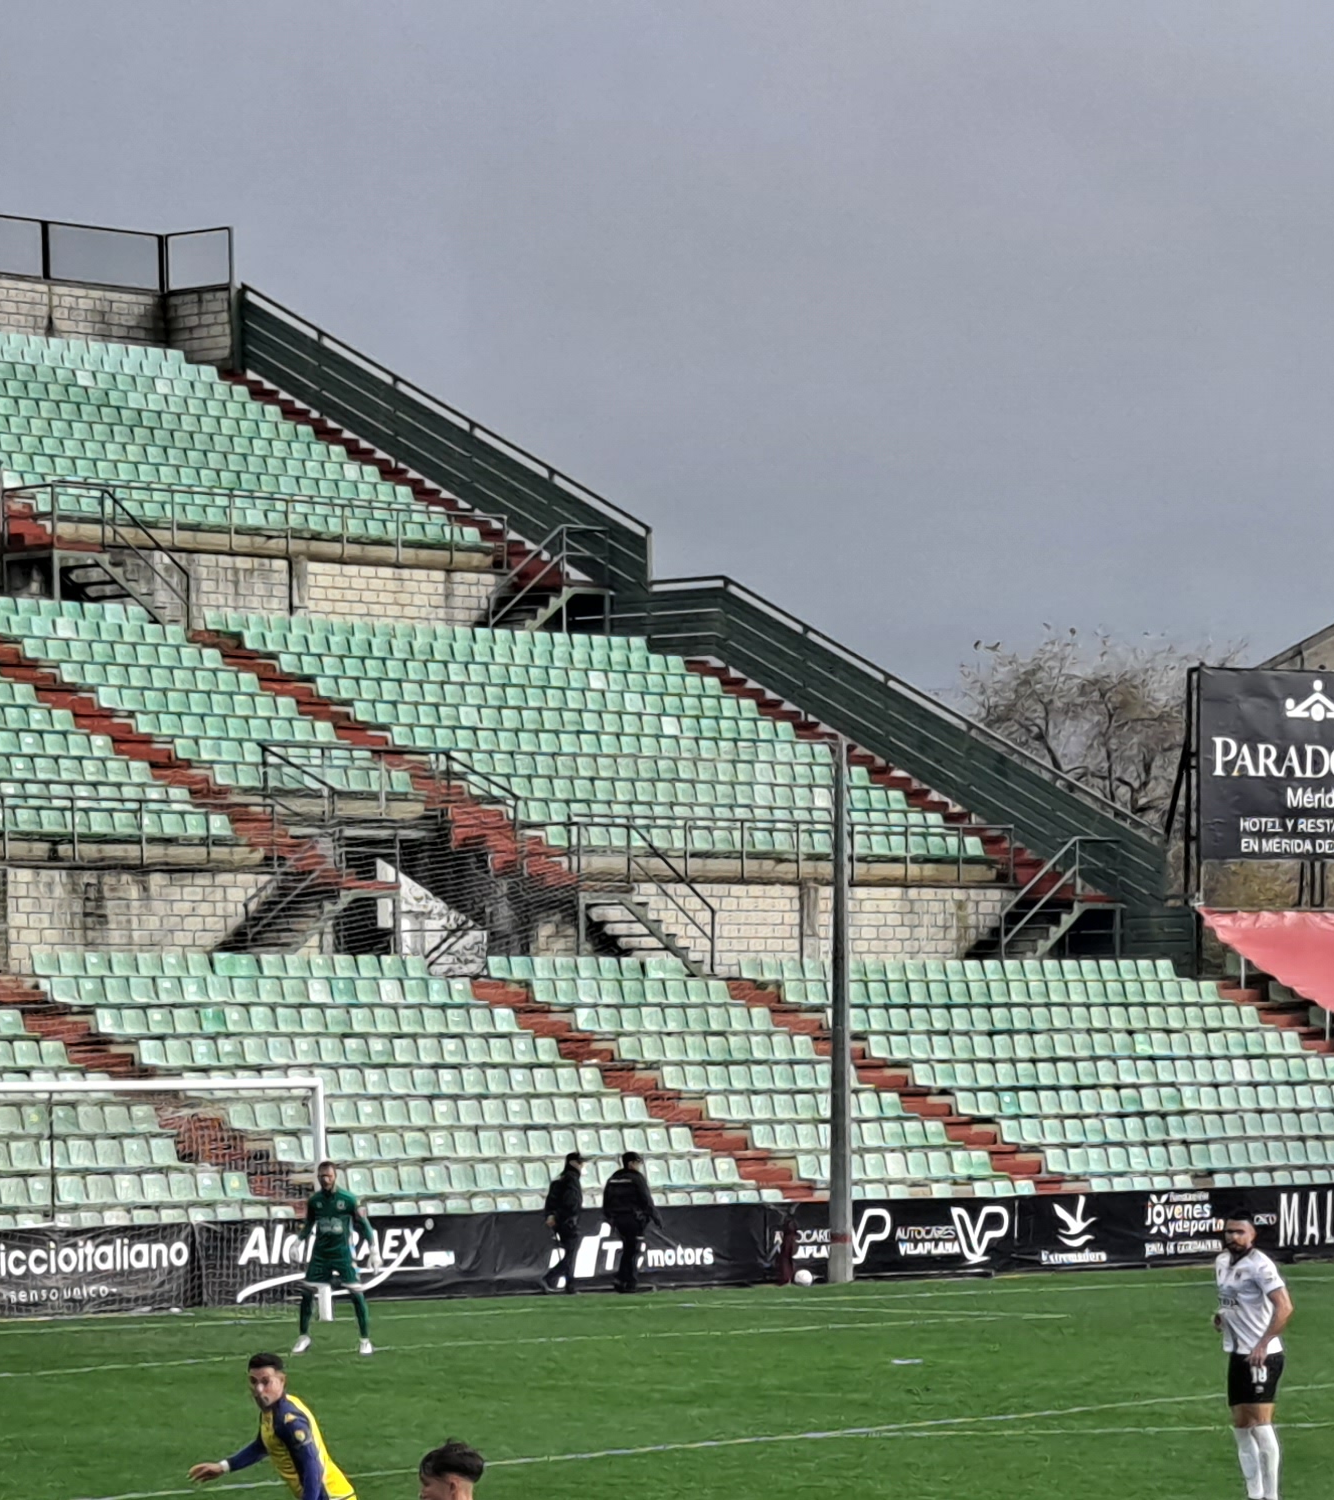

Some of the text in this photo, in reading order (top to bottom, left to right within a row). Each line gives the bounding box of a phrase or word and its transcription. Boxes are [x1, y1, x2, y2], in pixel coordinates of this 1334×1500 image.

[1240, 817, 1283, 832] HOTEL
[1286, 819, 1294, 832] Y
[1241, 838, 1259, 853] EN
[647, 1243, 715, 1268] motors
